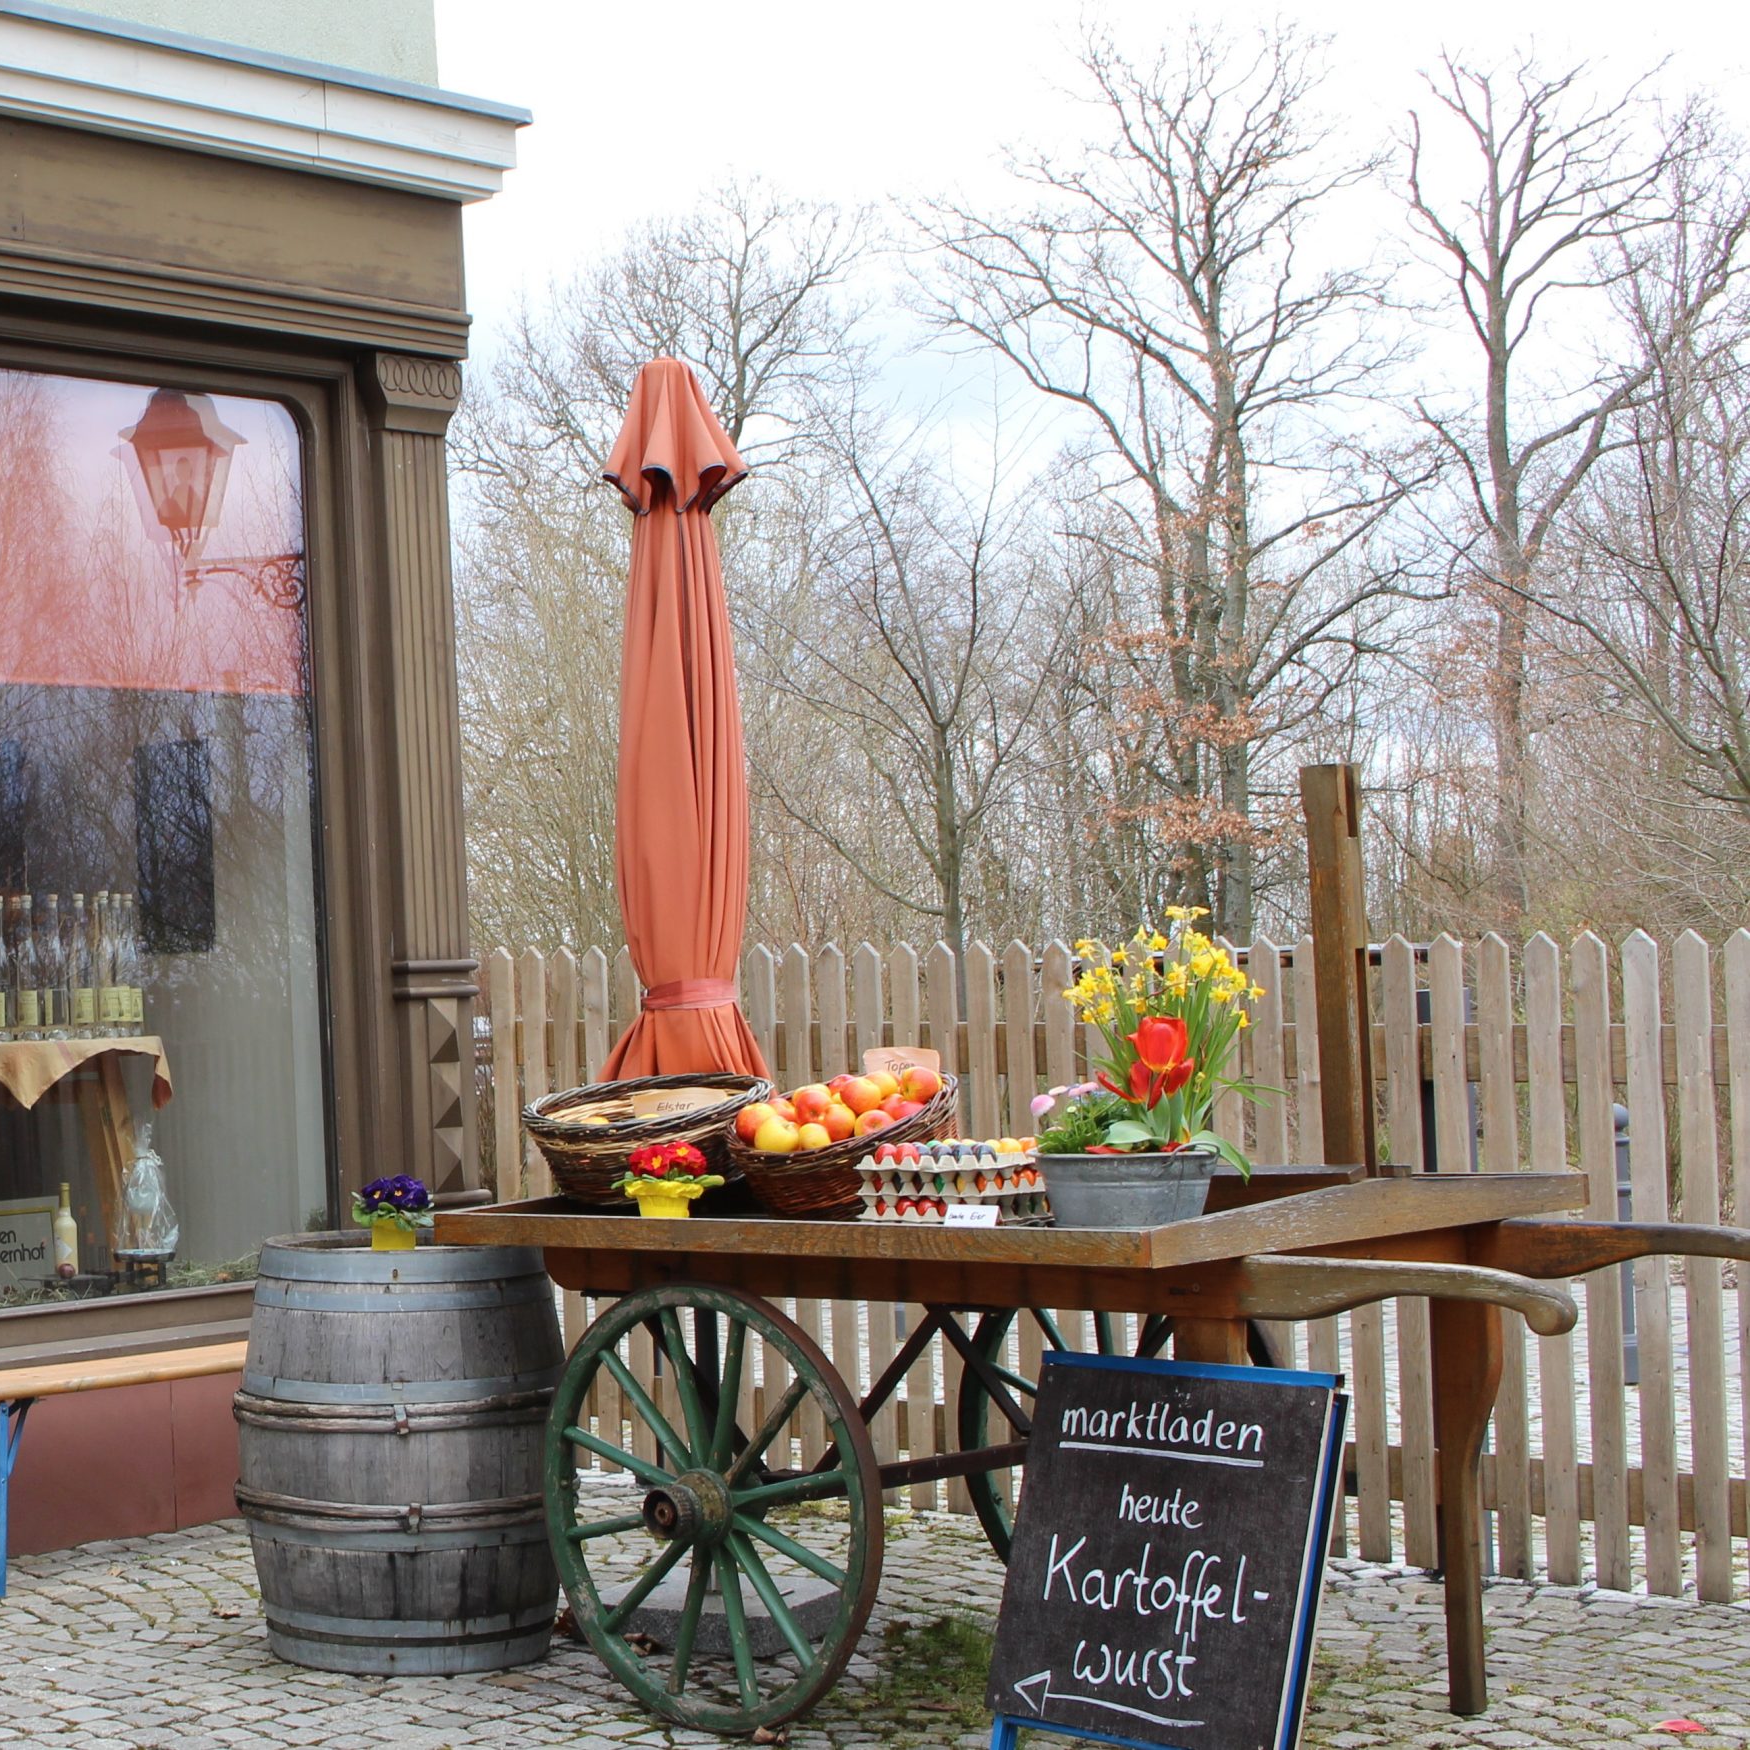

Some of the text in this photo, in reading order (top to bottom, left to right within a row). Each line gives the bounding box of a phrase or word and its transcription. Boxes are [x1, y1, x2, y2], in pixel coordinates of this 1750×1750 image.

[656, 1102, 695, 1112] Elstar
[1061, 1401, 1264, 1453] marktladen
[1118, 1483, 1203, 1529] heute
[1043, 1533, 1270, 1643] Kartoffel-
[1073, 1631, 1198, 1701] wurst
